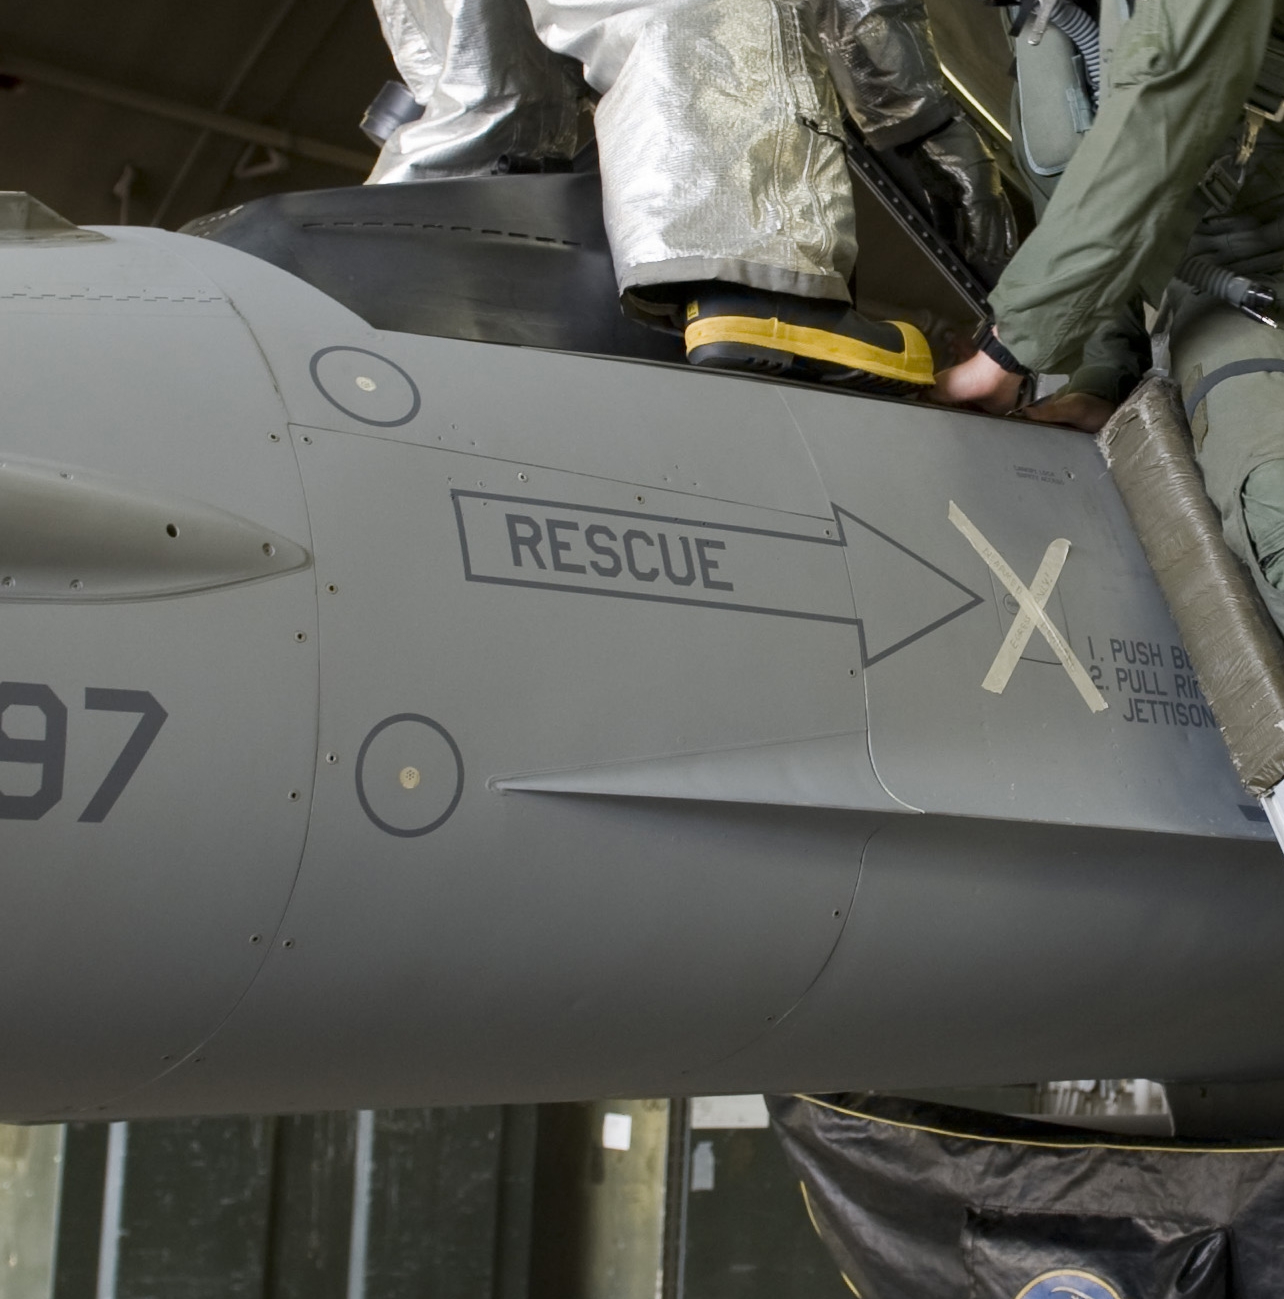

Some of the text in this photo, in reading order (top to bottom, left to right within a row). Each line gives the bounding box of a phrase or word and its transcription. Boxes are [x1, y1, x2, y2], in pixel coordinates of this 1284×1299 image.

[505, 513, 734, 592] RESCUE
[1110, 638, 1164, 668] PUSH
[1089, 665, 1109, 690] 2.
[1115, 668, 1168, 696] PULL
[1123, 698, 1217, 729] JETTISON
[0, 681, 169, 823] 97
